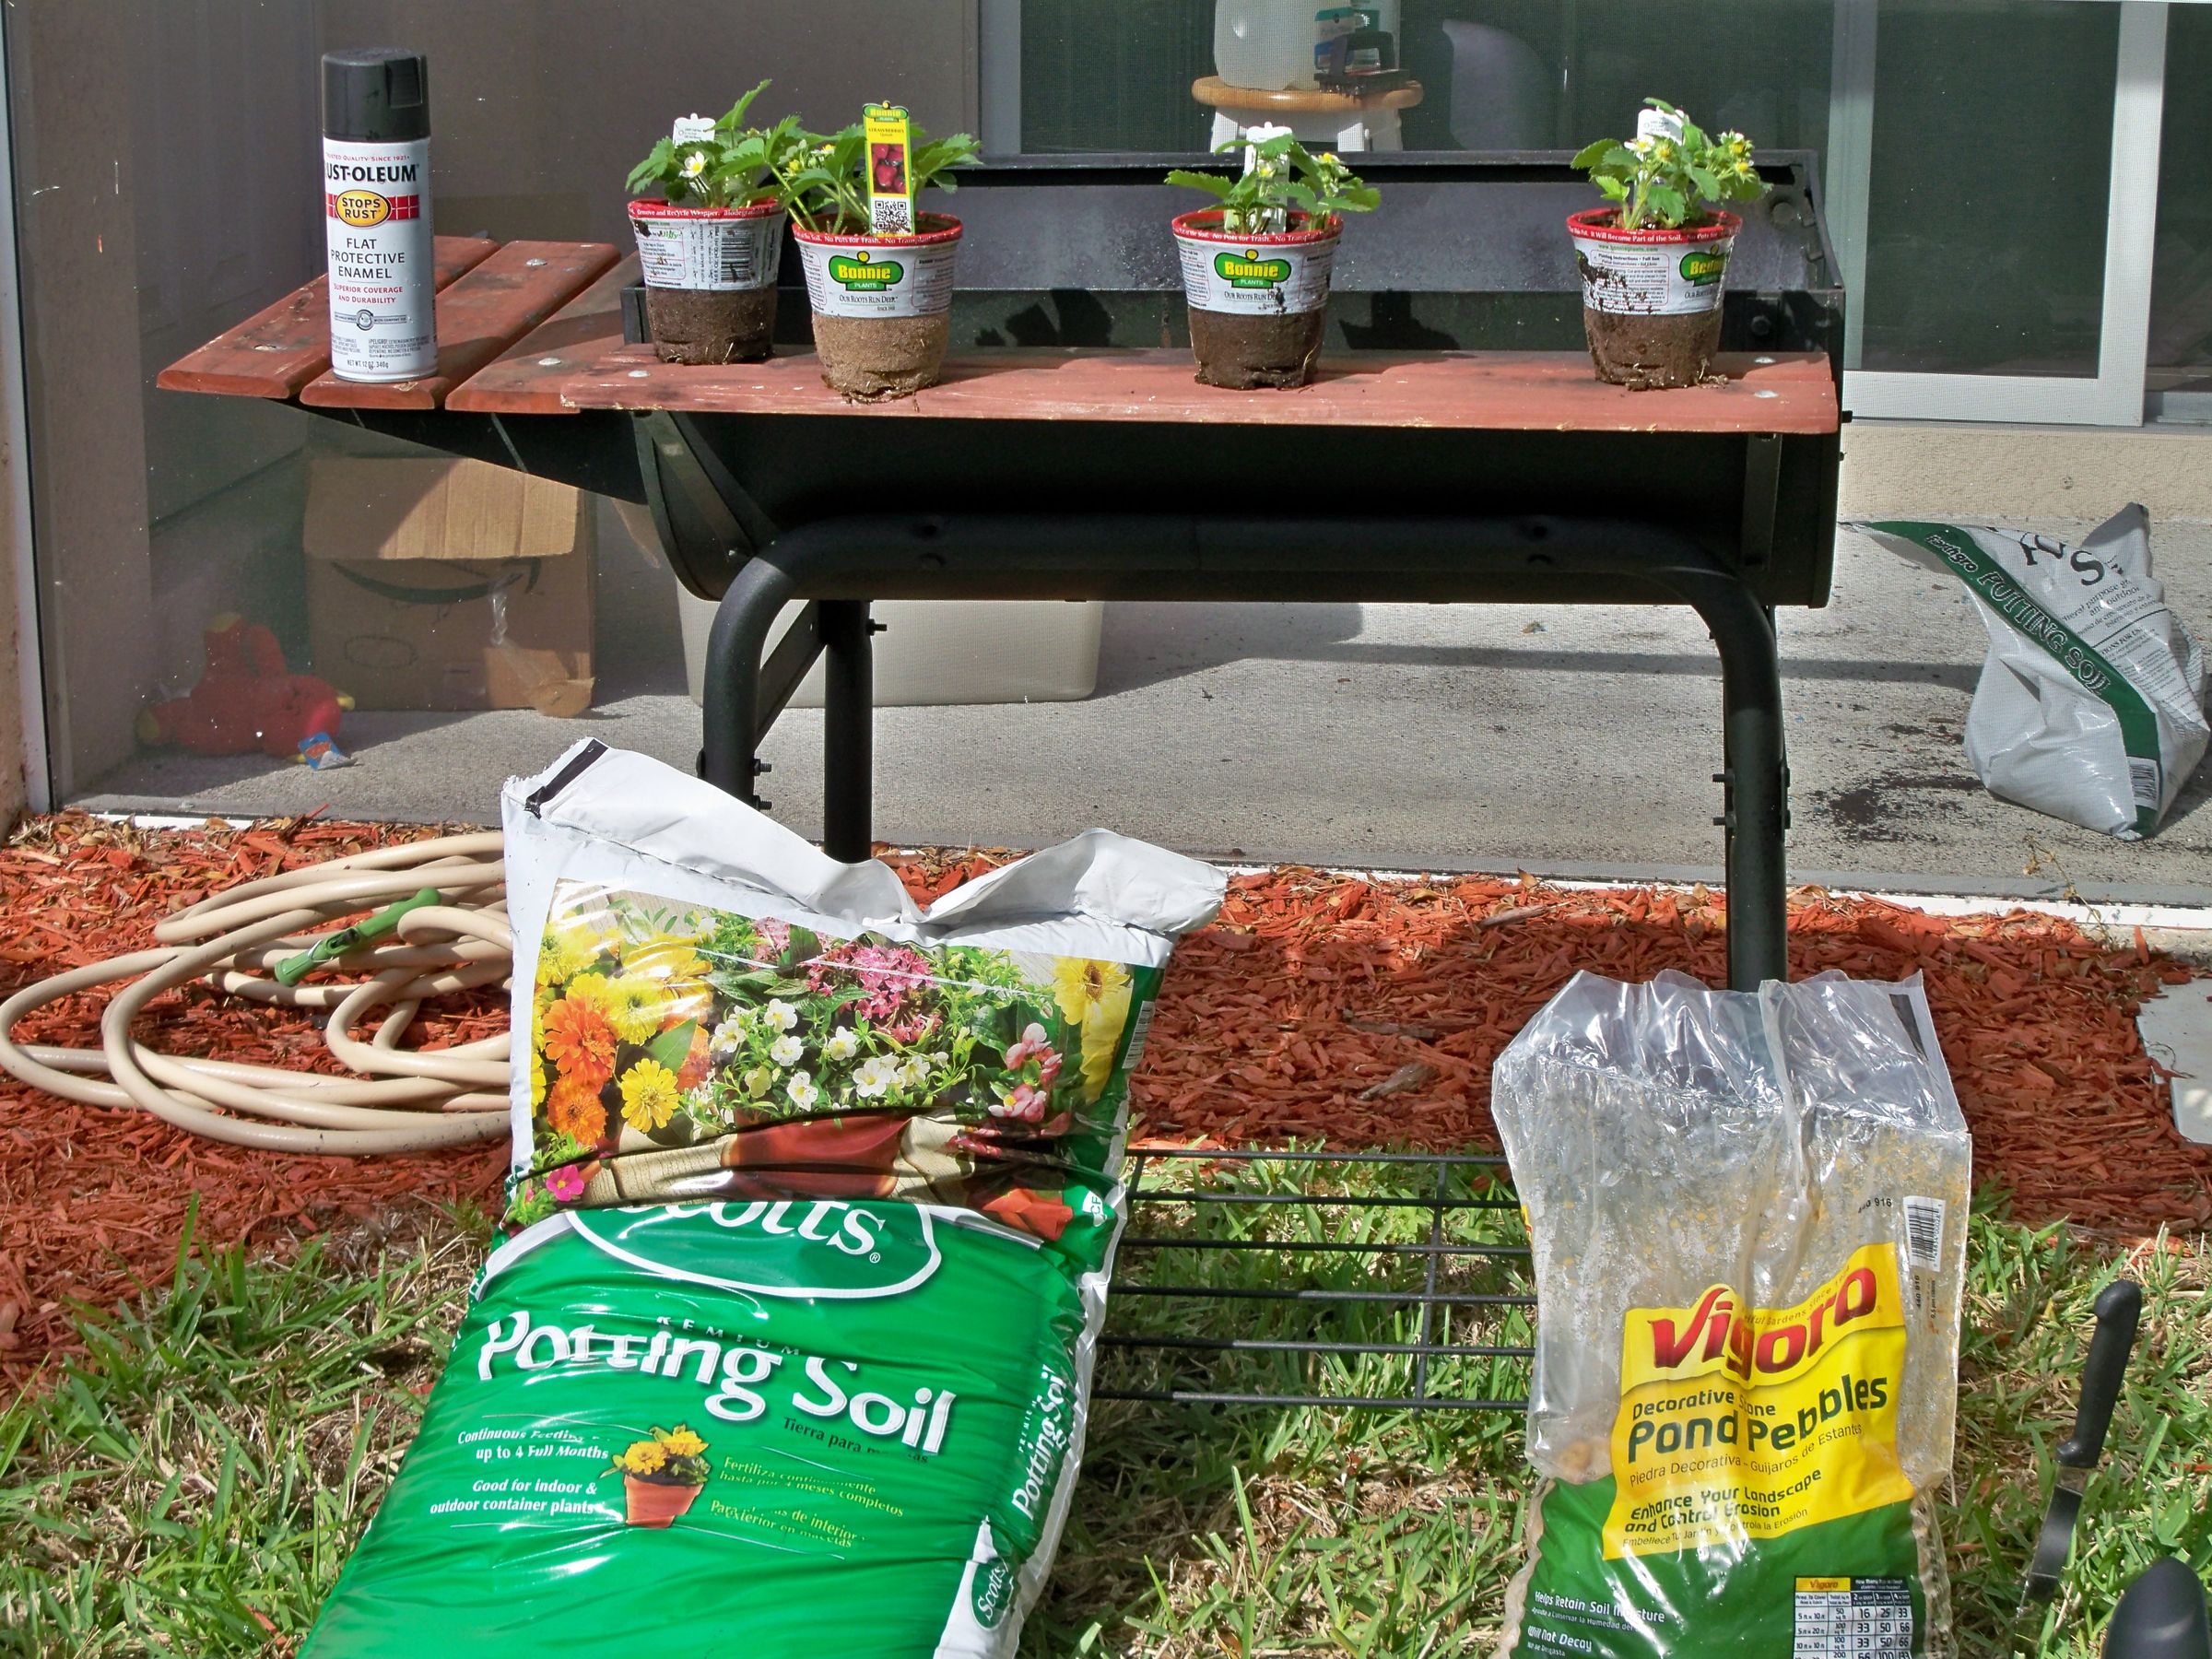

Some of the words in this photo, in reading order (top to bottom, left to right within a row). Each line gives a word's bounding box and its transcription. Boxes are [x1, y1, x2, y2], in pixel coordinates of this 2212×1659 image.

[326, 162, 417, 182] UST-OLEUM
[342, 197, 381, 208] STOPS
[345, 209, 376, 219] RUST
[347, 238, 377, 250] FLAT
[824, 234, 834, 242] No
[835, 235, 849, 243] Pots
[1595, 231, 1606, 240] Will
[1607, 233, 1631, 241] Become
[331, 249, 406, 265] PROTECTIVE
[338, 265, 393, 279] ENAMEL
[837, 264, 891, 280] Bonnie
[1224, 261, 1278, 277] Bonnie
[334, 283, 361, 293] SUPERIOR
[363, 286, 404, 294] COVERAGE
[1224, 290, 1235, 300] OUR
[1236, 292, 1253, 300] ROOTS
[338, 294, 350, 302] AND
[351, 296, 396, 304] DURABILITY
[839, 294, 850, 302] OUR
[851, 295, 868, 303] ROOTS
[1875, 1197, 1892, 1208] 916
[604, 1199, 887, 1256] otts
[1647, 1266, 1877, 1382] Vigoro
[1766, 1310, 1807, 1326] Gardens
[478, 1310, 783, 1421] Potting
[792, 1356, 957, 1454] Soil
[1632, 1389, 1735, 1421] Decorative
[1628, 1409, 1740, 1465] Pond
[1747, 1373, 1888, 1453] Pebbles
[457, 1428, 526, 1445] Continuous
[783, 1416, 826, 1441] Tierra
[828, 1433, 863, 1453] para
[476, 1446, 493, 1464] up
[496, 1445, 512, 1460] to
[515, 1445, 524, 1459] 4
[527, 1444, 554, 1458] Full
[555, 1444, 609, 1461] Months
[1630, 1461, 1666, 1488] Piedra
[1669, 1453, 1742, 1475] Decorativa
[1749, 1454, 1799, 1477] Guijaros
[1800, 1441, 1816, 1460] de
[1818, 1422, 1863, 1447] Estantes
[724, 1456, 776, 1478] Fertiliza
[1011, 1415, 1068, 1522] Potting
[472, 1478, 509, 1492] Good
[510, 1477, 532, 1493] for
[534, 1477, 583, 1494] indoor
[585, 1481, 598, 1495] &
[719, 1470, 754, 1485] hasta
[795, 1482, 836, 1497] meses
[839, 1490, 904, 1519] completos
[1630, 1493, 1693, 1521] Enhance
[1700, 1486, 1740, 1505] Your
[1744, 1468, 1822, 1504] Landscape
[429, 1498, 480, 1515] outdoor
[482, 1497, 548, 1512] container
[549, 1498, 595, 1516] plants
[791, 1509, 808, 1524] de
[810, 1512, 858, 1541] interior
[1624, 1519, 1657, 1535] and
[1660, 1507, 1719, 1530] Control
[1724, 1501, 1781, 1519] Erosion
[1622, 1535, 1672, 1548] Embellece
[1763, 1520, 1772, 1531] la
[1773, 1507, 1807, 1530] Erosión
[1809, 1579, 1839, 1590] Vigoro
[977, 1565, 1007, 1622] Scotts
[1535, 1591, 1554, 1606] Helps
[1555, 1594, 1586, 1612] Retain
[1589, 1600, 1611, 1616] Soil
[1859, 1607, 1871, 1618] 16
[1880, 1607, 1891, 1618] 25
[1898, 1607, 1908, 1618] 33
[1579, 1616, 1586, 1624] la
[1586, 1617, 1621, 1630] Humedad
[1812, 1627, 1820, 1635] 20
[1857, 1622, 1870, 1633] 33
[1880, 1622, 1891, 1633] 50
[1900, 1622, 1911, 1633] 66
[1527, 1625, 1542, 1639] Will
[1541, 1628, 1558, 1643] Not
[1559, 1632, 1594, 1653] Decay
[1857, 1637, 1870, 1648] 33
[1880, 1637, 1892, 1648] 50
[1899, 1637, 1909, 1648] 66
